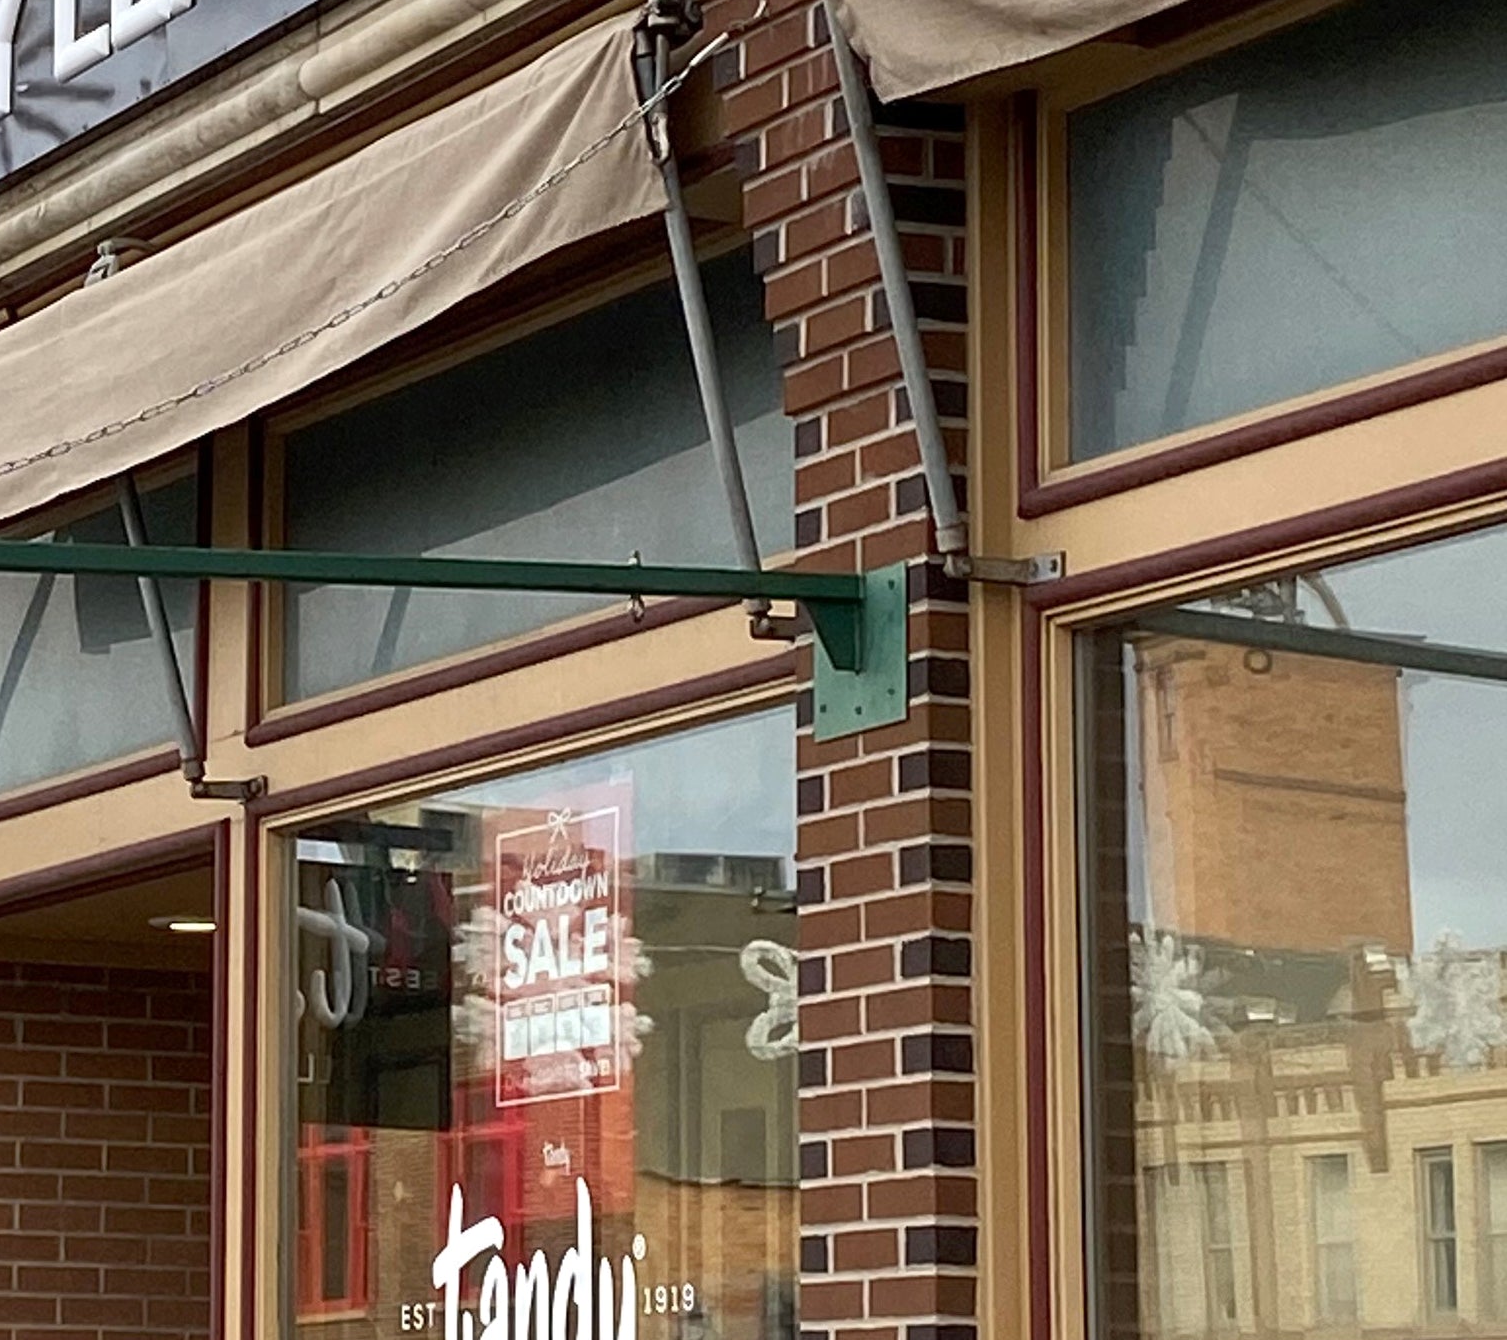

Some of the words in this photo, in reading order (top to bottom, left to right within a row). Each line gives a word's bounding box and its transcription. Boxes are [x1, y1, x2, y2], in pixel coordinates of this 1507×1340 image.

[503, 872, 609, 916] COUNTDOWN
[503, 906, 609, 990] SALE
[400, 1302, 437, 1331] EST
[643, 1282, 694, 1315] 1919
